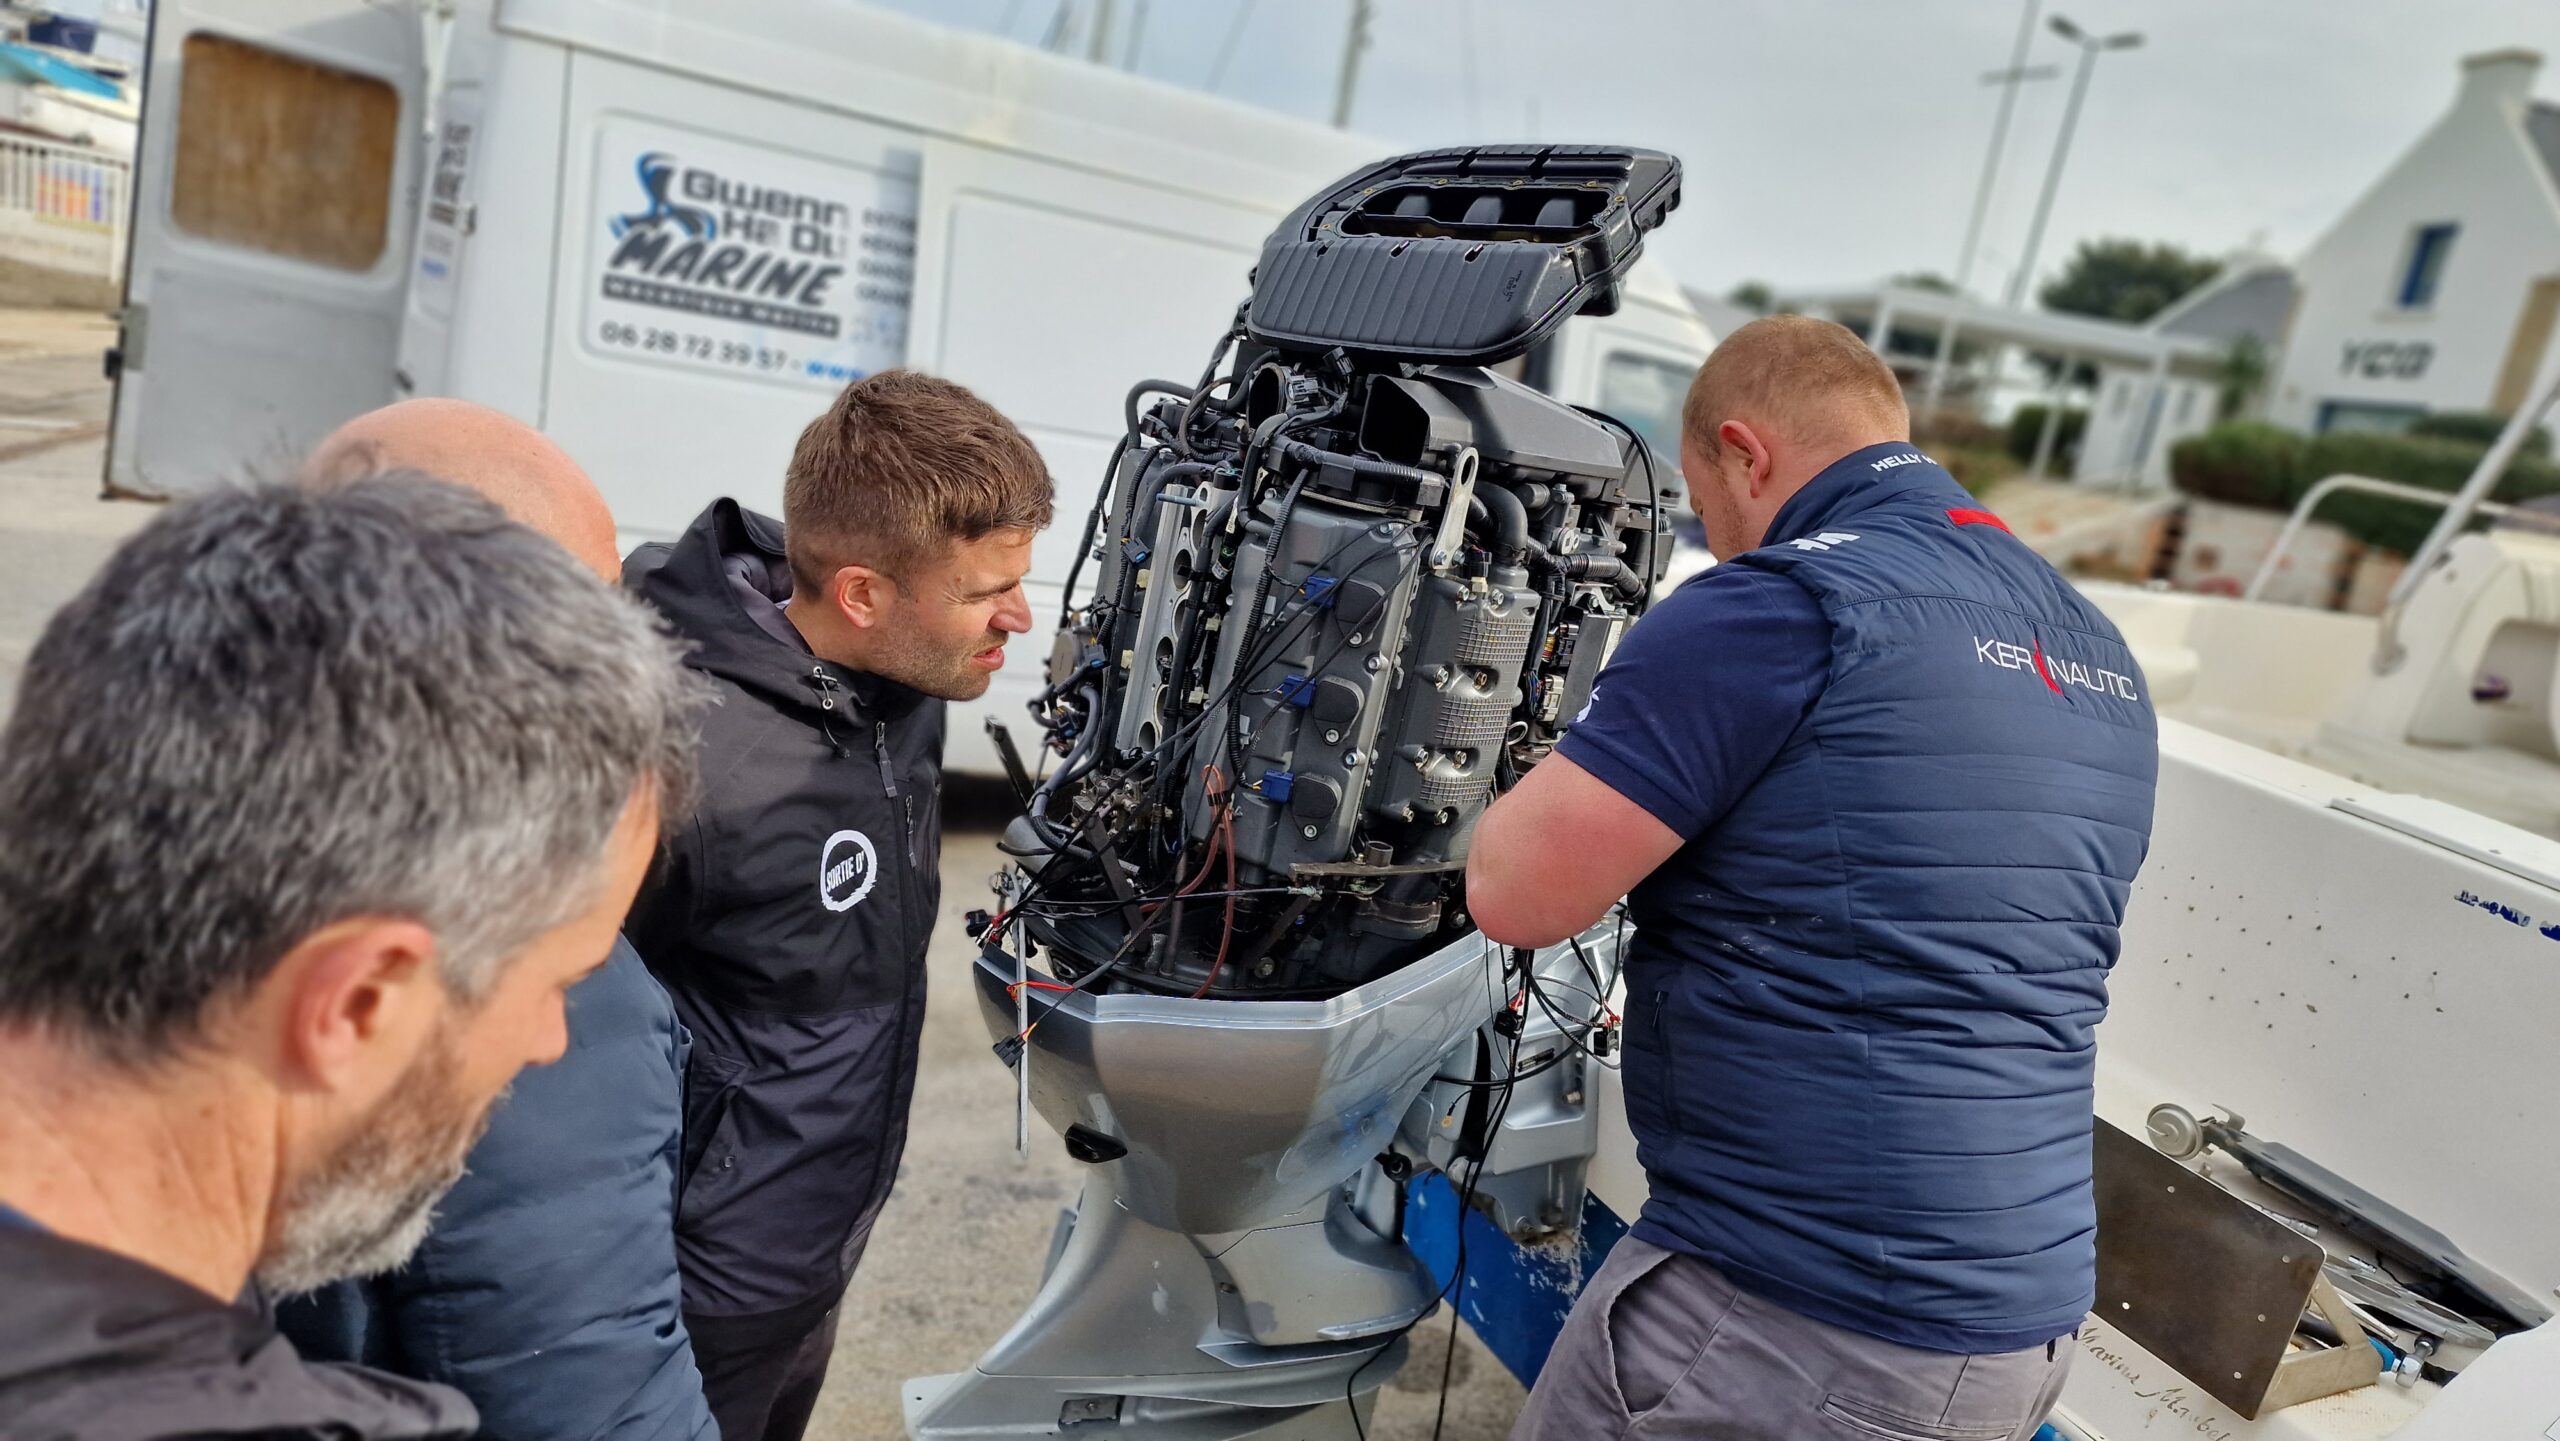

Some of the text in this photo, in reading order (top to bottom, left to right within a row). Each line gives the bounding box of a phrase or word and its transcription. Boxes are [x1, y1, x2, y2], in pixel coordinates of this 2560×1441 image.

[609, 230, 845, 307] MARINE
[600, 320, 638, 346] 06
[1870, 453, 1922, 472] HELLY
[826, 856, 855, 893] SORTIE
